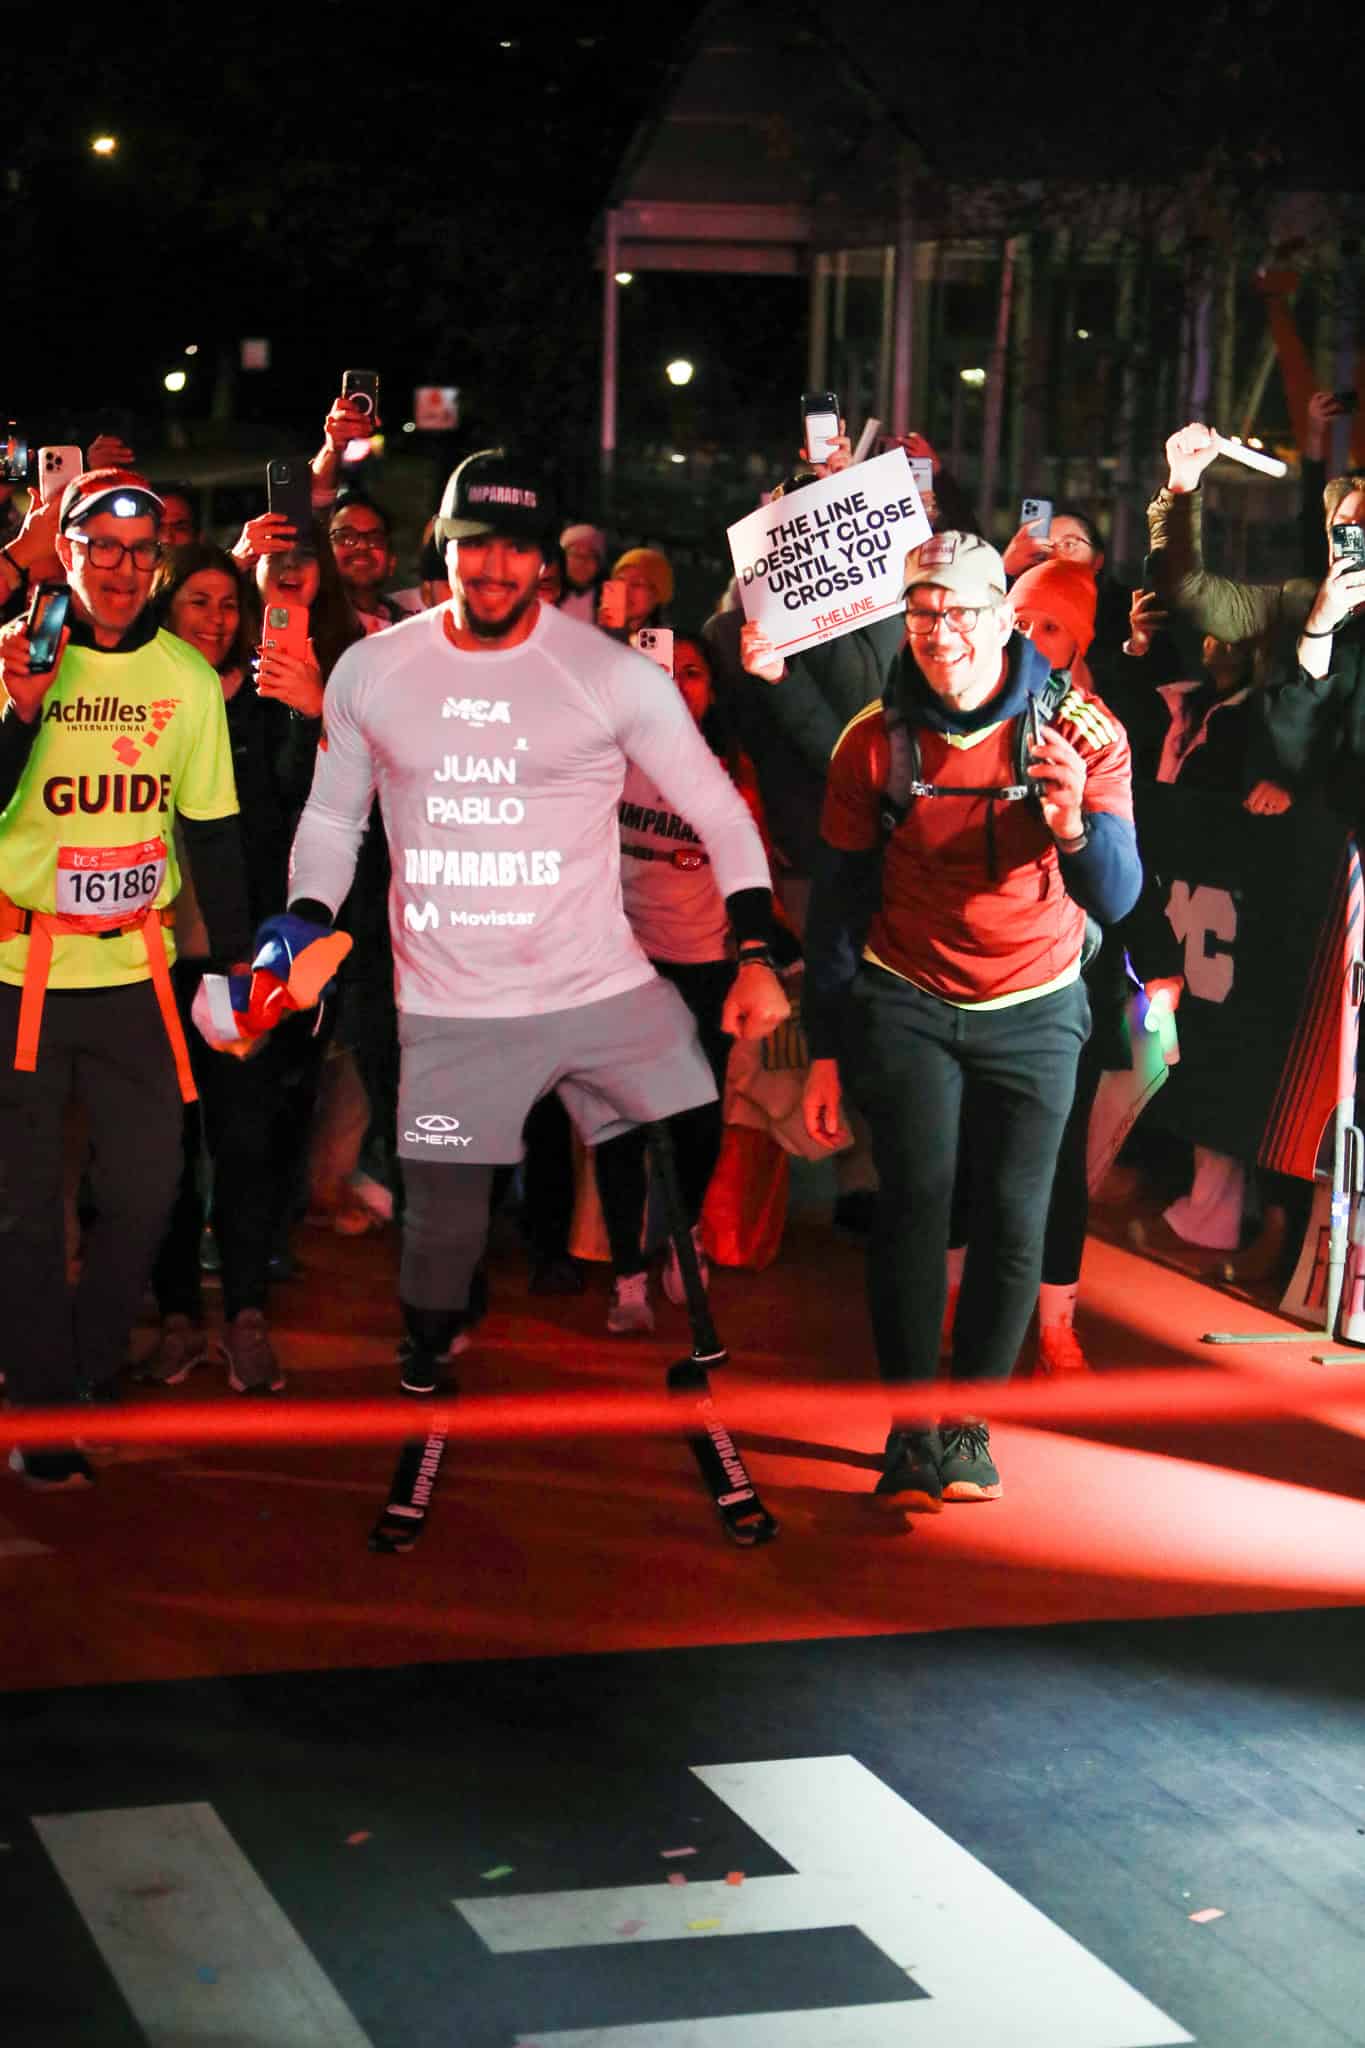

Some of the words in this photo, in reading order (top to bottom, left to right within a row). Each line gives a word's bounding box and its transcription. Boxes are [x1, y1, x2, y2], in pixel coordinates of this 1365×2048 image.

[767, 515, 811, 547] THE
[813, 491, 868, 528] LINE
[836, 497, 916, 541] CLOSE
[768, 554, 837, 593] UNTIL
[839, 530, 891, 564] YOU
[783, 566, 864, 610] CROSS
[868, 554, 888, 579] IT
[43, 696, 147, 722] Achilles
[66, 723, 145, 732] INTERNATIONAL
[433, 754, 516, 784] JUAN
[426, 796, 524, 824] PABLO
[69, 863, 157, 903] 16186
[450, 909, 536, 926] Movistar
[404, 1131, 473, 1147] CHERY
